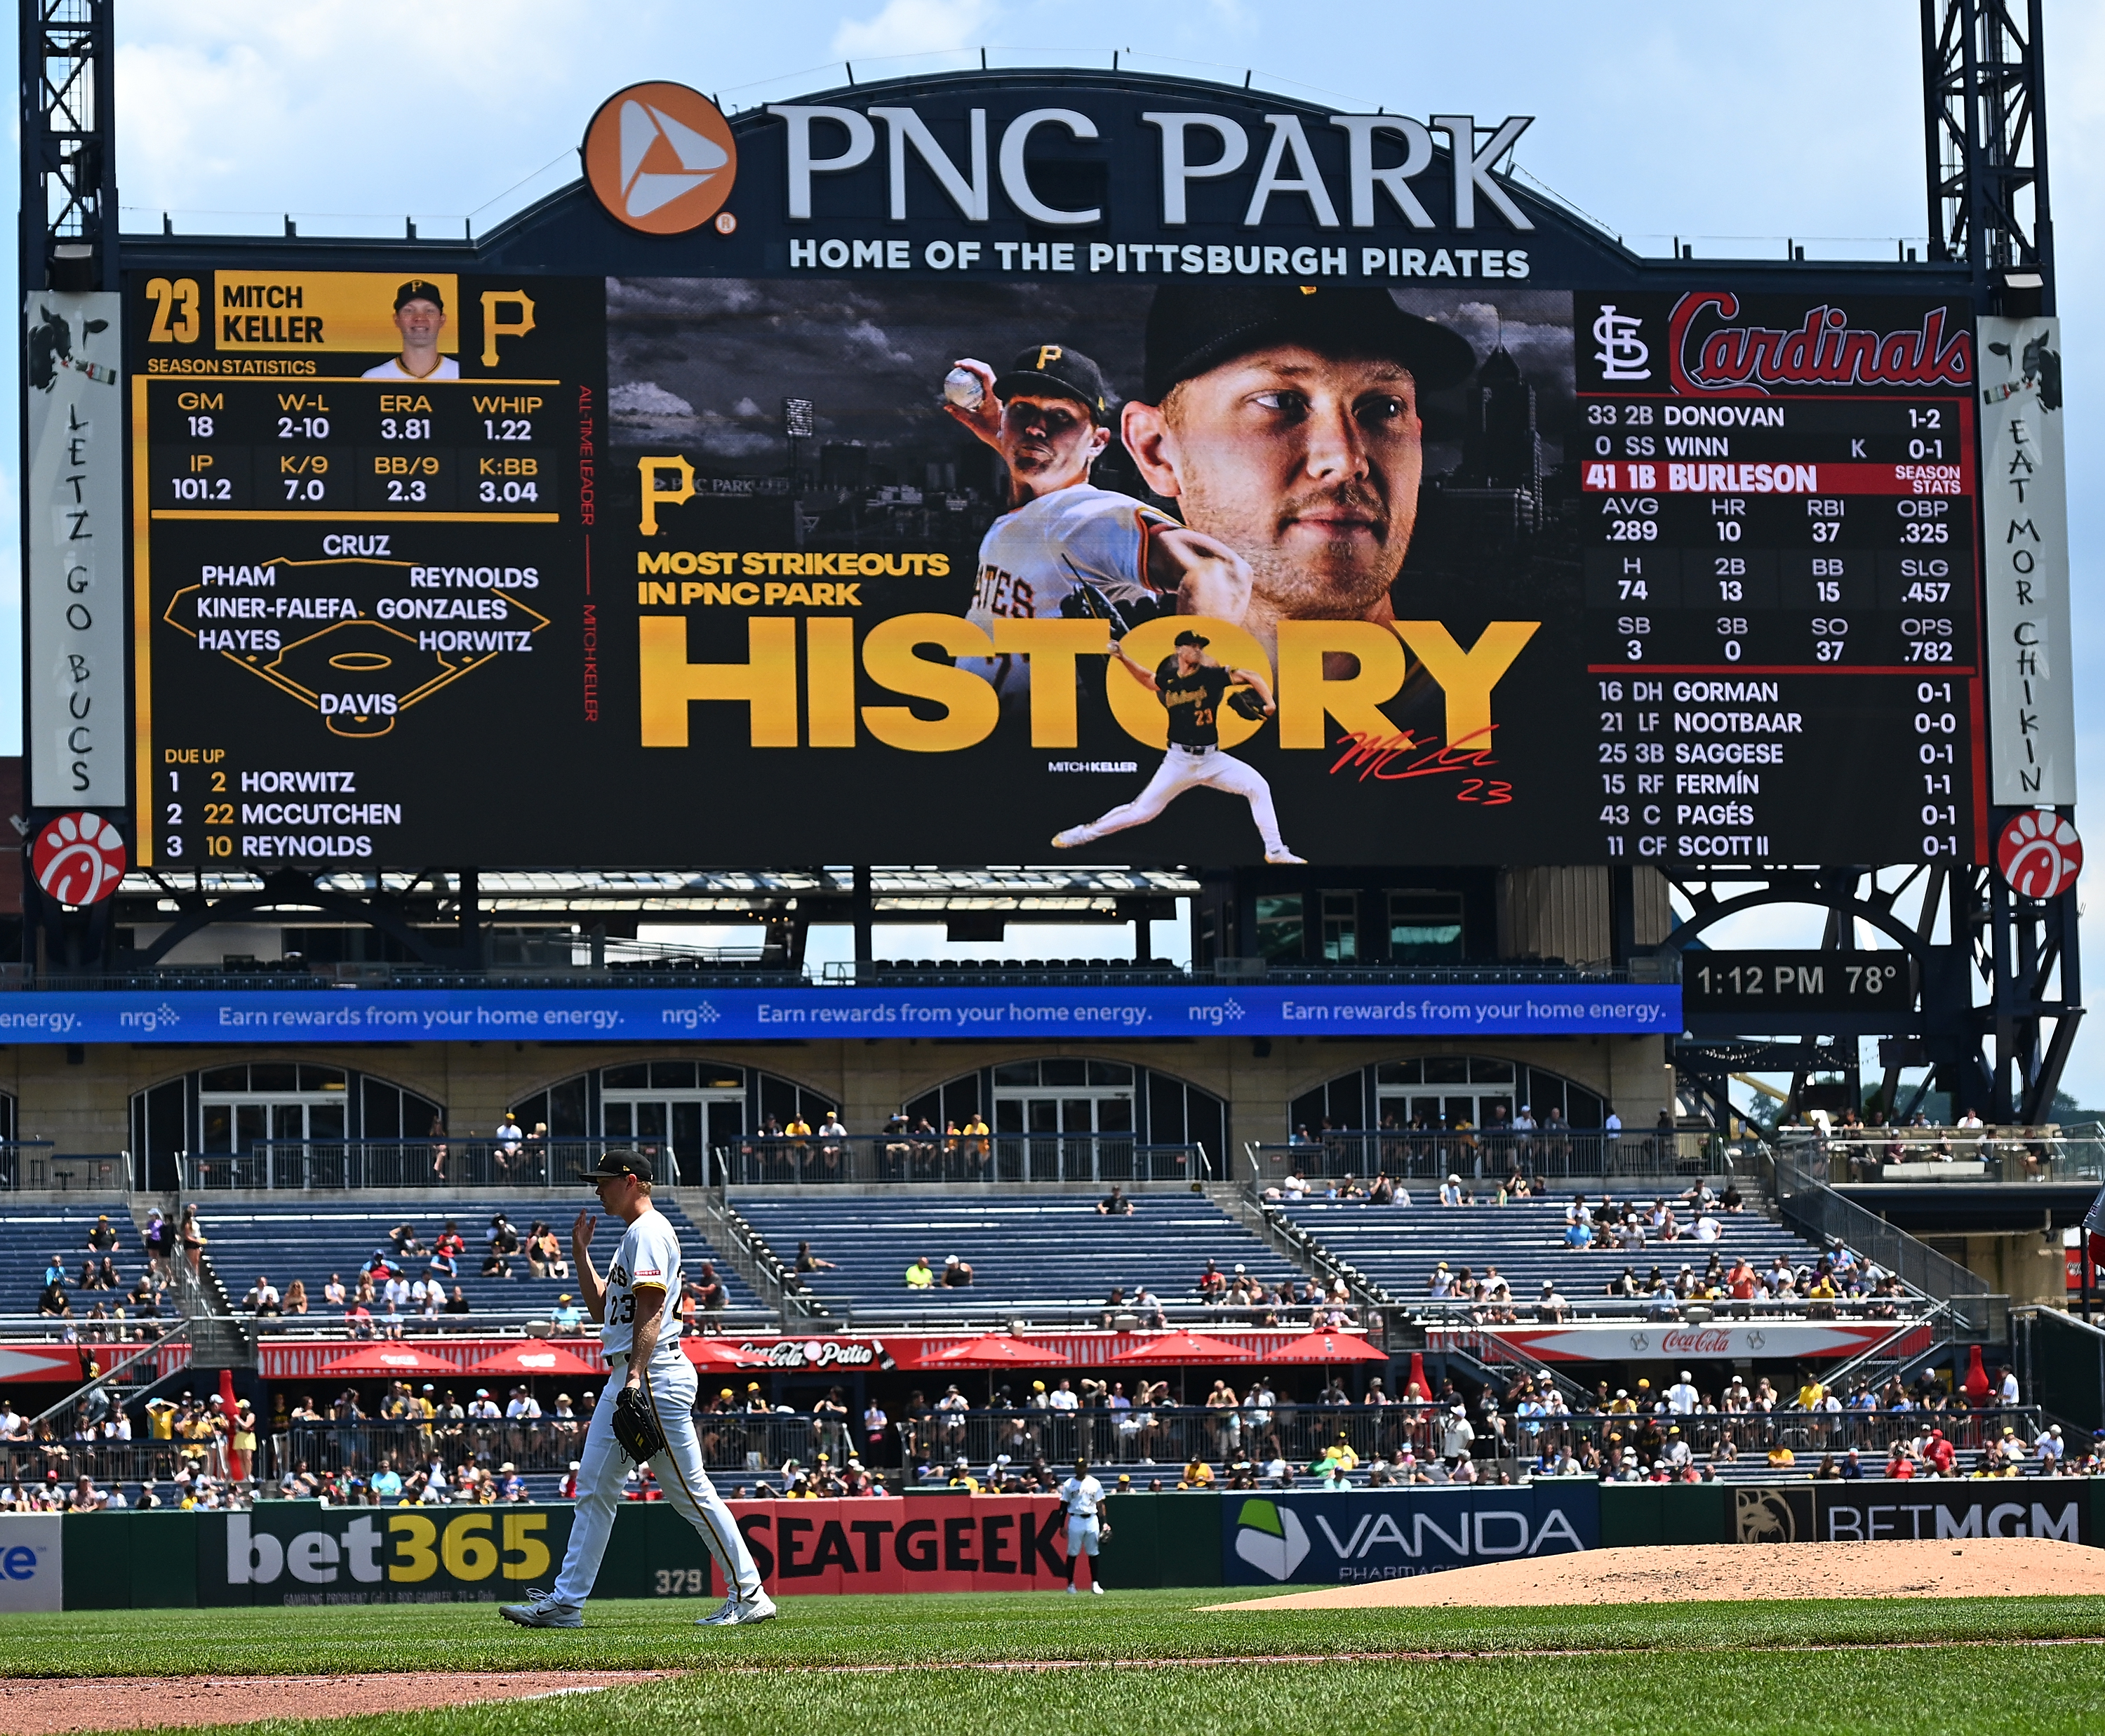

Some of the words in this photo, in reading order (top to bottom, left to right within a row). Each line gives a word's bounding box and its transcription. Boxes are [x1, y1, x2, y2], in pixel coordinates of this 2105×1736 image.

[764, 103, 1102, 225] PNC
[1142, 112, 1536, 230] PARK
[790, 239, 910, 268] HOME
[925, 241, 980, 269] OF
[994, 242, 1075, 270] THE
[1090, 243, 1346, 274] PITTSBURGH
[1363, 248, 1529, 278] PIRATES
[223, 286, 302, 308] MITCH
[145, 277, 200, 345] 23
[223, 315, 323, 343] KELLER
[1669, 291, 1973, 396] Cardinals
[149, 359, 218, 373] SEASON
[222, 360, 316, 374] STATISTICS
[178, 392, 222, 410] GM
[278, 394, 328, 410] W-L
[381, 395, 432, 412] ERA
[473, 396, 542, 413] WHIP
[188, 416, 213, 436] 18
[579, 385, 594, 456] ALL-TIME
[1589, 406, 1617, 424] 33
[1625, 406, 1653, 425] 2B
[1665, 406, 1784, 427] DONOVAN
[1909, 409, 1940, 428] 1-2
[279, 418, 329, 438] 2-10
[382, 419, 429, 439] 3.81
[484, 420, 531, 440] 1.22
[1626, 436, 1655, 455] SS
[1666, 436, 1728, 456] WINN
[1909, 439, 1942, 459] 0-1
[66, 404, 92, 540] LETZ
[192, 455, 213, 472] IP
[281, 456, 328, 473] K/9
[375, 457, 439, 474] BB/9
[481, 458, 537, 475] K:BB
[2009, 420, 2033, 504] EAT
[1586, 465, 1615, 489] 41
[1628, 465, 1656, 490] 1B
[1669, 465, 1817, 492] BURLESON
[1896, 466, 1960, 480] SEASON
[173, 479, 231, 499] 101.2
[284, 480, 324, 500] 7.0
[388, 481, 426, 501] 2.3
[480, 481, 538, 502] 3.04
[580, 459, 595, 526] LEADER
[1913, 480, 1961, 494] STATS
[1603, 498, 1658, 514] AVG
[1712, 499, 1745, 515] HR
[1808, 500, 1844, 516] RBI
[1897, 500, 1948, 517] OBP
[1607, 521, 1657, 540] .289
[1717, 521, 1741, 541] 10
[1813, 522, 1840, 542] 37
[1901, 523, 1948, 542] .325
[323, 535, 390, 555] CRUZ
[638, 552, 737, 575] MOST
[742, 552, 949, 576] STRIKEOUTS
[1716, 558, 1745, 575] 2B
[1813, 559, 1843, 575] BB
[1902, 559, 1949, 576] SLG
[2007, 519, 2041, 606] MOR
[201, 566, 276, 587] PHAM
[410, 567, 539, 589] REYNOLDS
[65, 566, 93, 631] GO
[639, 582, 676, 604] IN
[681, 582, 759, 605] PNC
[765, 582, 862, 606] PARK
[1618, 580, 1648, 600] 74
[1720, 581, 1742, 601] 13
[1817, 582, 1840, 601] 15
[1902, 582, 1951, 602] .457
[198, 598, 357, 618] KINER-FALEFA
[376, 598, 508, 620] GONZALES
[582, 604, 597, 660] MITCH
[1618, 617, 1650, 634] SB
[1718, 617, 1748, 634] 3B
[1812, 618, 1847, 635] SO
[1902, 619, 1952, 636] OPS
[198, 629, 281, 650] HAYES
[418, 630, 533, 651] HORWITZ
[1817, 641, 1843, 661] 37
[1905, 642, 1952, 661] .782
[584, 662, 599, 722] KELLER
[639, 613, 1543, 754] HISTORY
[1599, 681, 1622, 700] 16
[1633, 682, 1662, 701] DH
[1673, 681, 1777, 702] GORMAN
[1918, 683, 1951, 702] 0-1
[320, 693, 398, 714] DAVIS
[2013, 622, 2042, 793] CHIKIN
[67, 655, 93, 792] BUCS
[1601, 712, 1622, 731] 21
[1639, 713, 1659, 731] LF
[1675, 712, 1802, 733] NOOTBAAR
[1916, 714, 1956, 733] 0-0
[166, 749, 199, 763] DUE
[203, 749, 225, 763] UP
[1599, 743, 1626, 763] 25
[1636, 743, 1664, 763] 3B
[1676, 743, 1783, 763] SAGGESE
[1920, 744, 1953, 763] 0-1
[1049, 762, 1090, 772] MITCH
[1091, 762, 1137, 772] KELLER
[242, 772, 355, 792] HORWITZ
[1457, 778, 1513, 806] 23
[1603, 775, 1625, 794] 15
[1638, 775, 1664, 793] RF
[1677, 770, 1758, 794] FERMÍN
[1924, 775, 1950, 794] 1-1
[204, 804, 233, 823] 22
[243, 803, 401, 824] MCCUTCHEN
[1600, 806, 1629, 824] 43
[1678, 801, 1753, 824] PAGÉS
[1922, 805, 1955, 824] 0-1
[206, 836, 232, 856] 10
[243, 836, 372, 856] REYNOLDS
[1608, 836, 1623, 855] 11
[1639, 836, 1666, 855] CF
[1679, 836, 1752, 856] SCOTT
[1923, 836, 1956, 855] 0-1
[1699, 967, 1763, 993] 1:12
[1776, 967, 1823, 993] PM
[1846, 966, 1896, 993] 78°
[220, 1007, 267, 1025] Earn
[274, 1007, 361, 1025] rewards
[366, 1006, 417, 1024] from
[424, 1010, 472, 1029] your
[478, 1006, 538, 1024] home
[544, 1010, 624, 1029] energy.
[759, 1005, 805, 1022] Earn
[811, 1004, 895, 1022] rewards
[900, 1003, 951, 1021] from
[957, 1008, 1004, 1026] your
[1010, 1003, 1069, 1020] home
[1074, 1007, 1152, 1025] energy.
[1283, 1002, 1328, 1020] Earn
[1334, 1001, 1416, 1020] rewards
[1422, 1001, 1471, 1019] from
[1476, 1006, 1522, 1023] your
[1528, 1001, 1584, 1017] home
[1590, 1005, 1666, 1022] energy.
[0, 1013, 81, 1032] energy.
[610, 1294, 636, 1326] 23
[1662, 1328, 1732, 1353] Coca-Cola
[817, 1342, 872, 1367] Patio
[1829, 1502, 2079, 1544] BETMGM
[738, 1509, 1068, 1578] SEATGEEK
[1316, 1508, 1584, 1559] VANDA
[227, 1514, 551, 1584] bet365
[655, 1569, 702, 1594] 379
